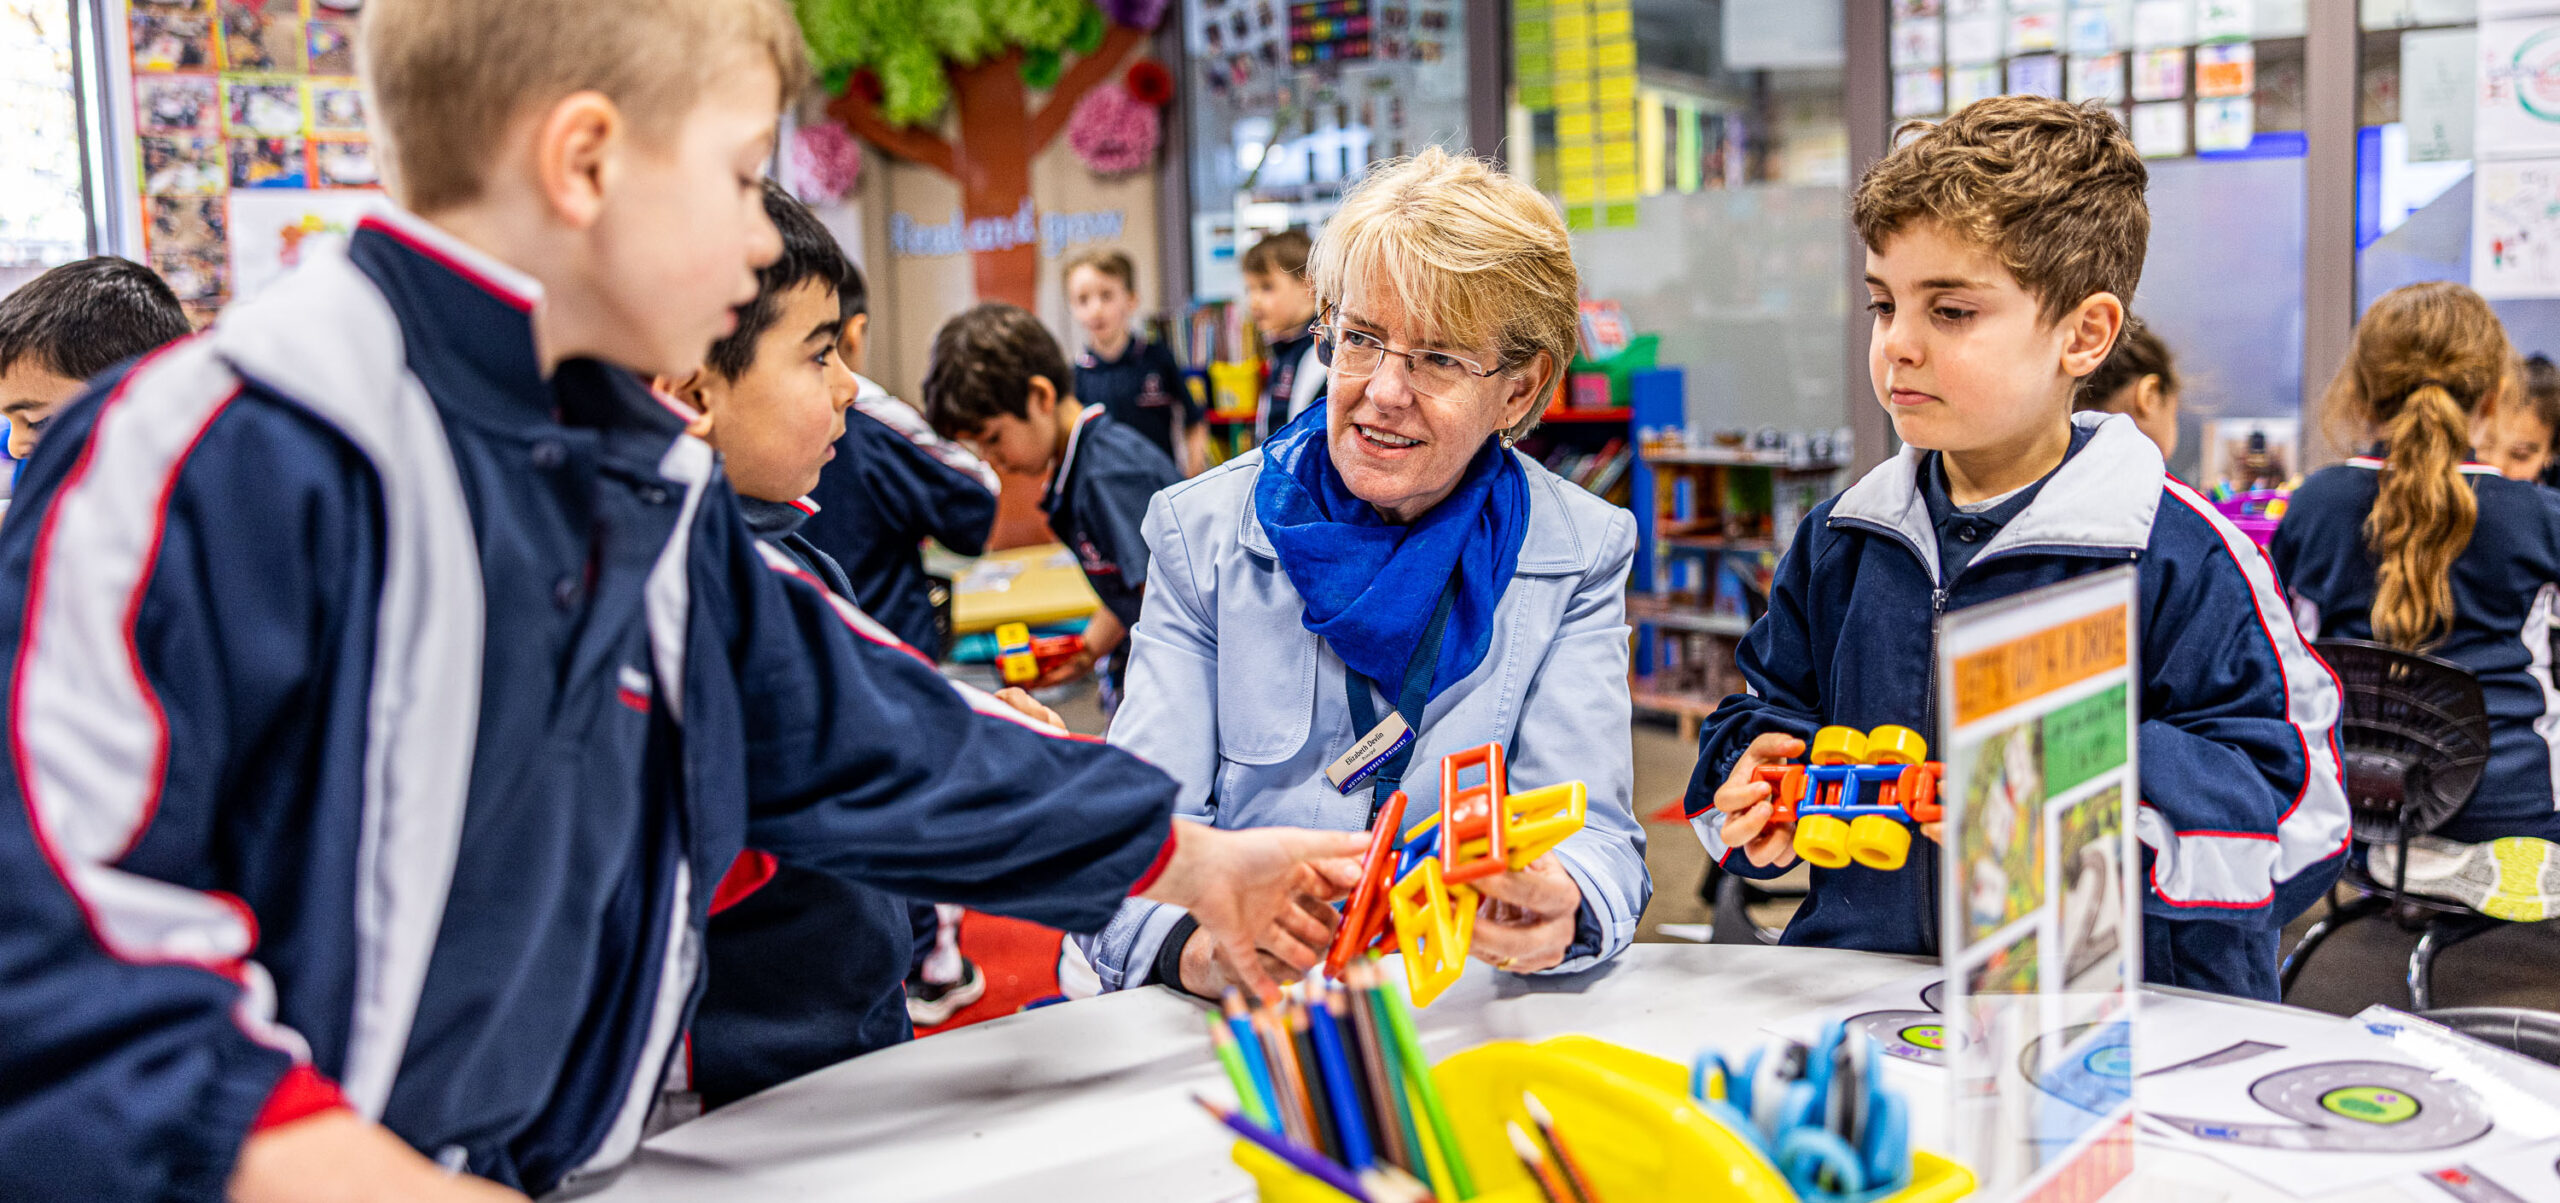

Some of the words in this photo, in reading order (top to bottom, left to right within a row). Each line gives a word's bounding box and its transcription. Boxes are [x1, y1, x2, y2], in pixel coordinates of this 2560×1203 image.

[1345, 744, 1369, 765] Elizabeth
[1366, 732, 1385, 747] Devlin
[1347, 771, 1367, 789] MOTHER
[1366, 757, 1386, 773] TERESA
[1385, 738, 1407, 758] PRIMARY
